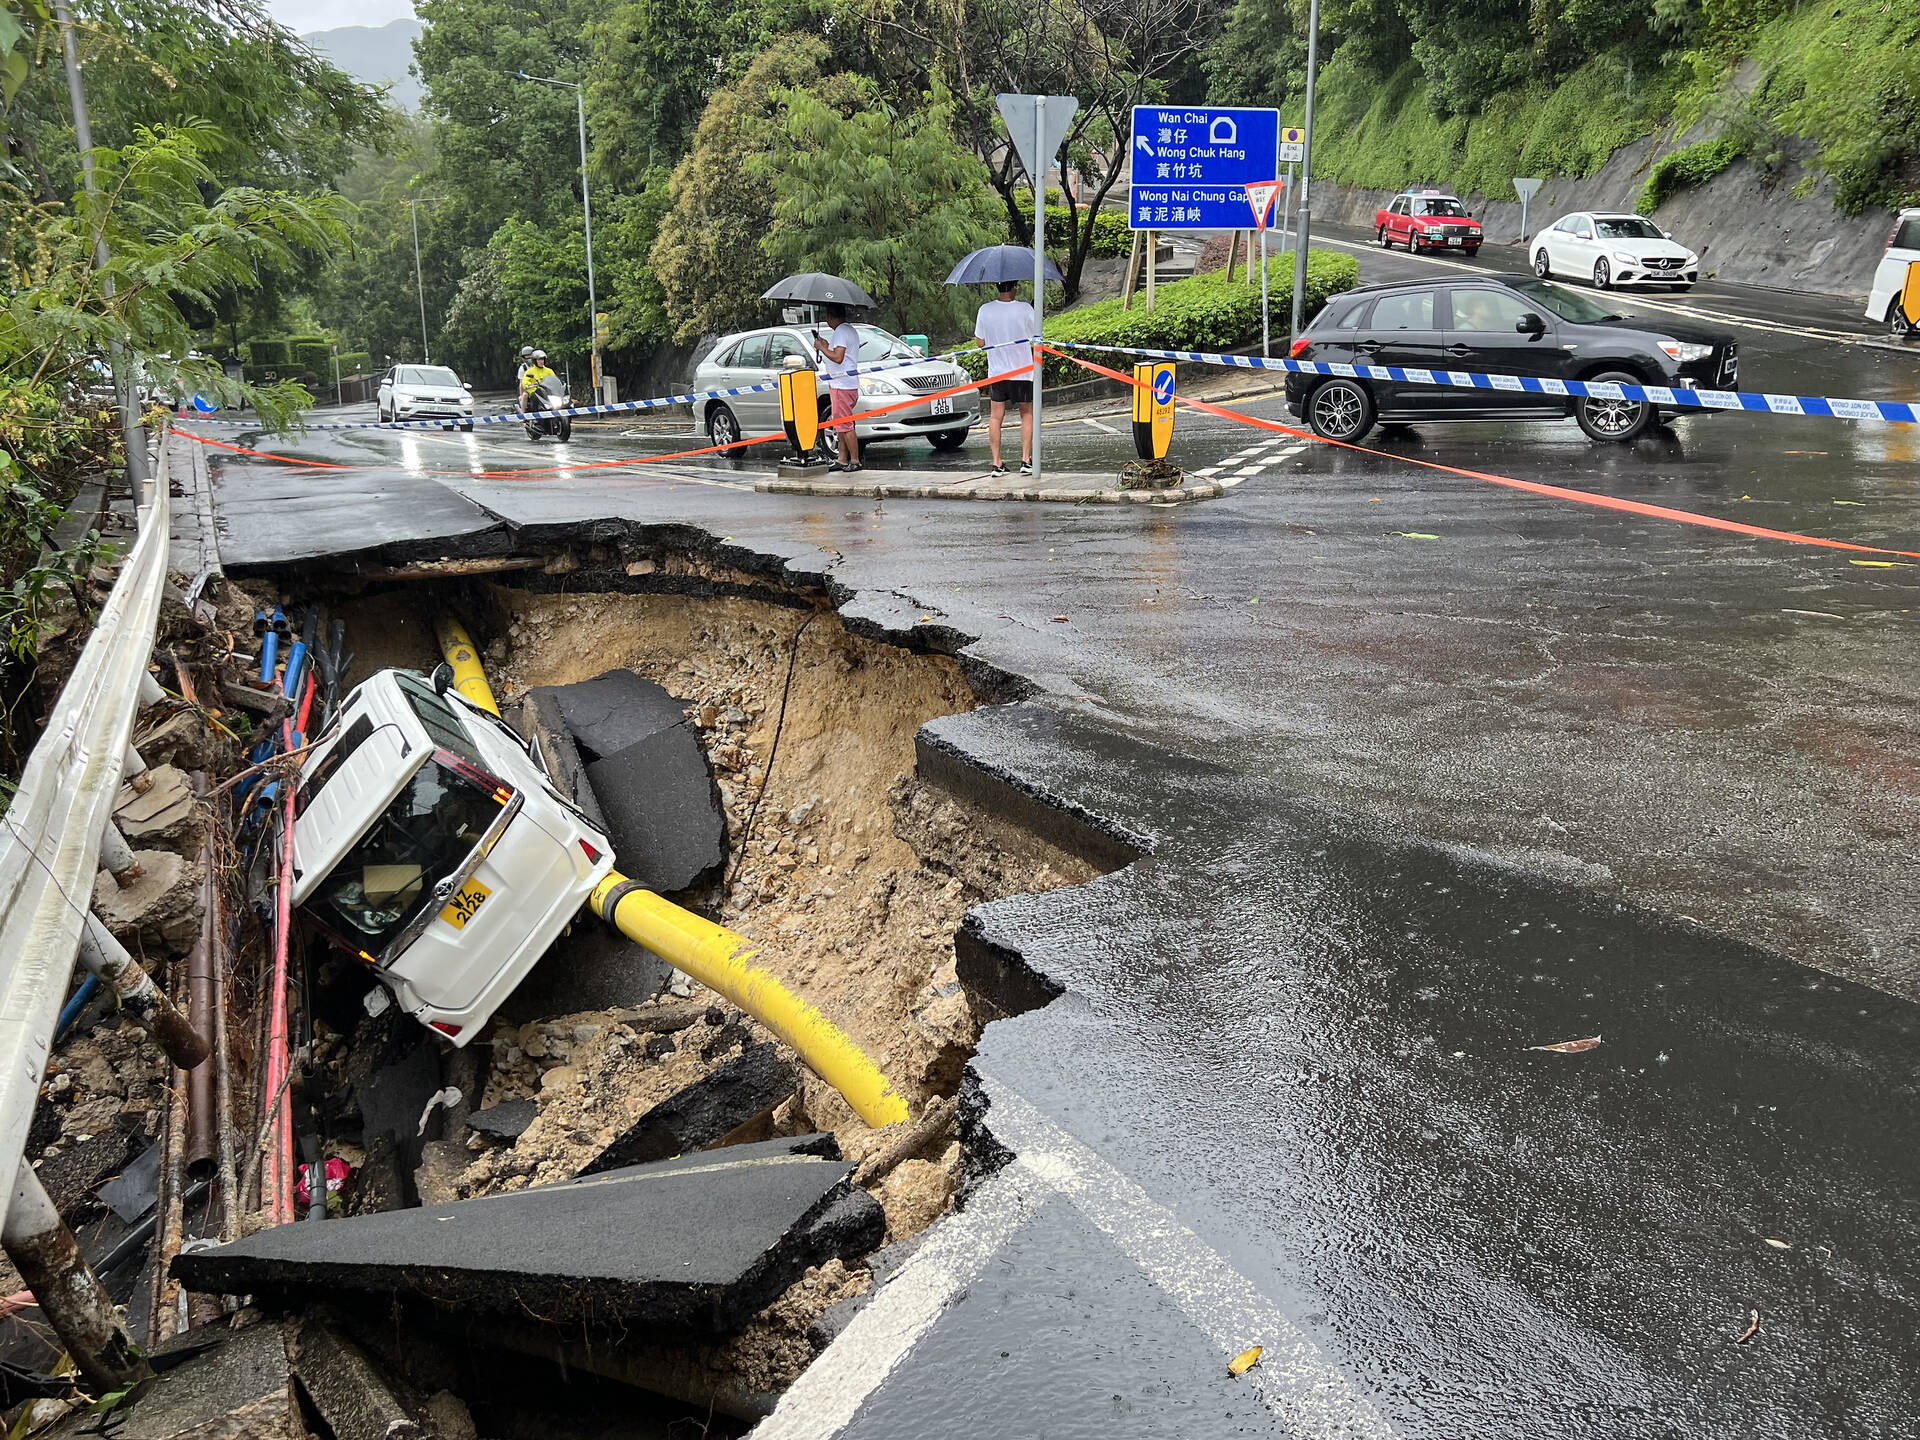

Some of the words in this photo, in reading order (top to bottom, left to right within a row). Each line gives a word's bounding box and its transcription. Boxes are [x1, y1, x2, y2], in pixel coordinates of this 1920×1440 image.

[1158, 112, 1181, 123] Wan
[1184, 112, 1208, 124] Chai
[1157, 128, 1188, 144] 灣仔
[1157, 146, 1186, 159] Wong
[1189, 147, 1216, 158] Chuk
[1219, 148, 1246, 160] Hang
[1156, 162, 1203, 178] 黃竹坑
[1139, 190, 1168, 203] Wong
[1171, 190, 1190, 201] Nai
[1192, 191, 1226, 203] Chung
[1228, 191, 1249, 203] Gap
[1138, 207, 1202, 222] 黃泥涌峽
[265, 371, 277, 380] 50
[937, 398, 947, 407] AH
[934, 405, 950, 415] 368
[449, 889, 473, 911] WZ
[457, 892, 486, 926] 2128
